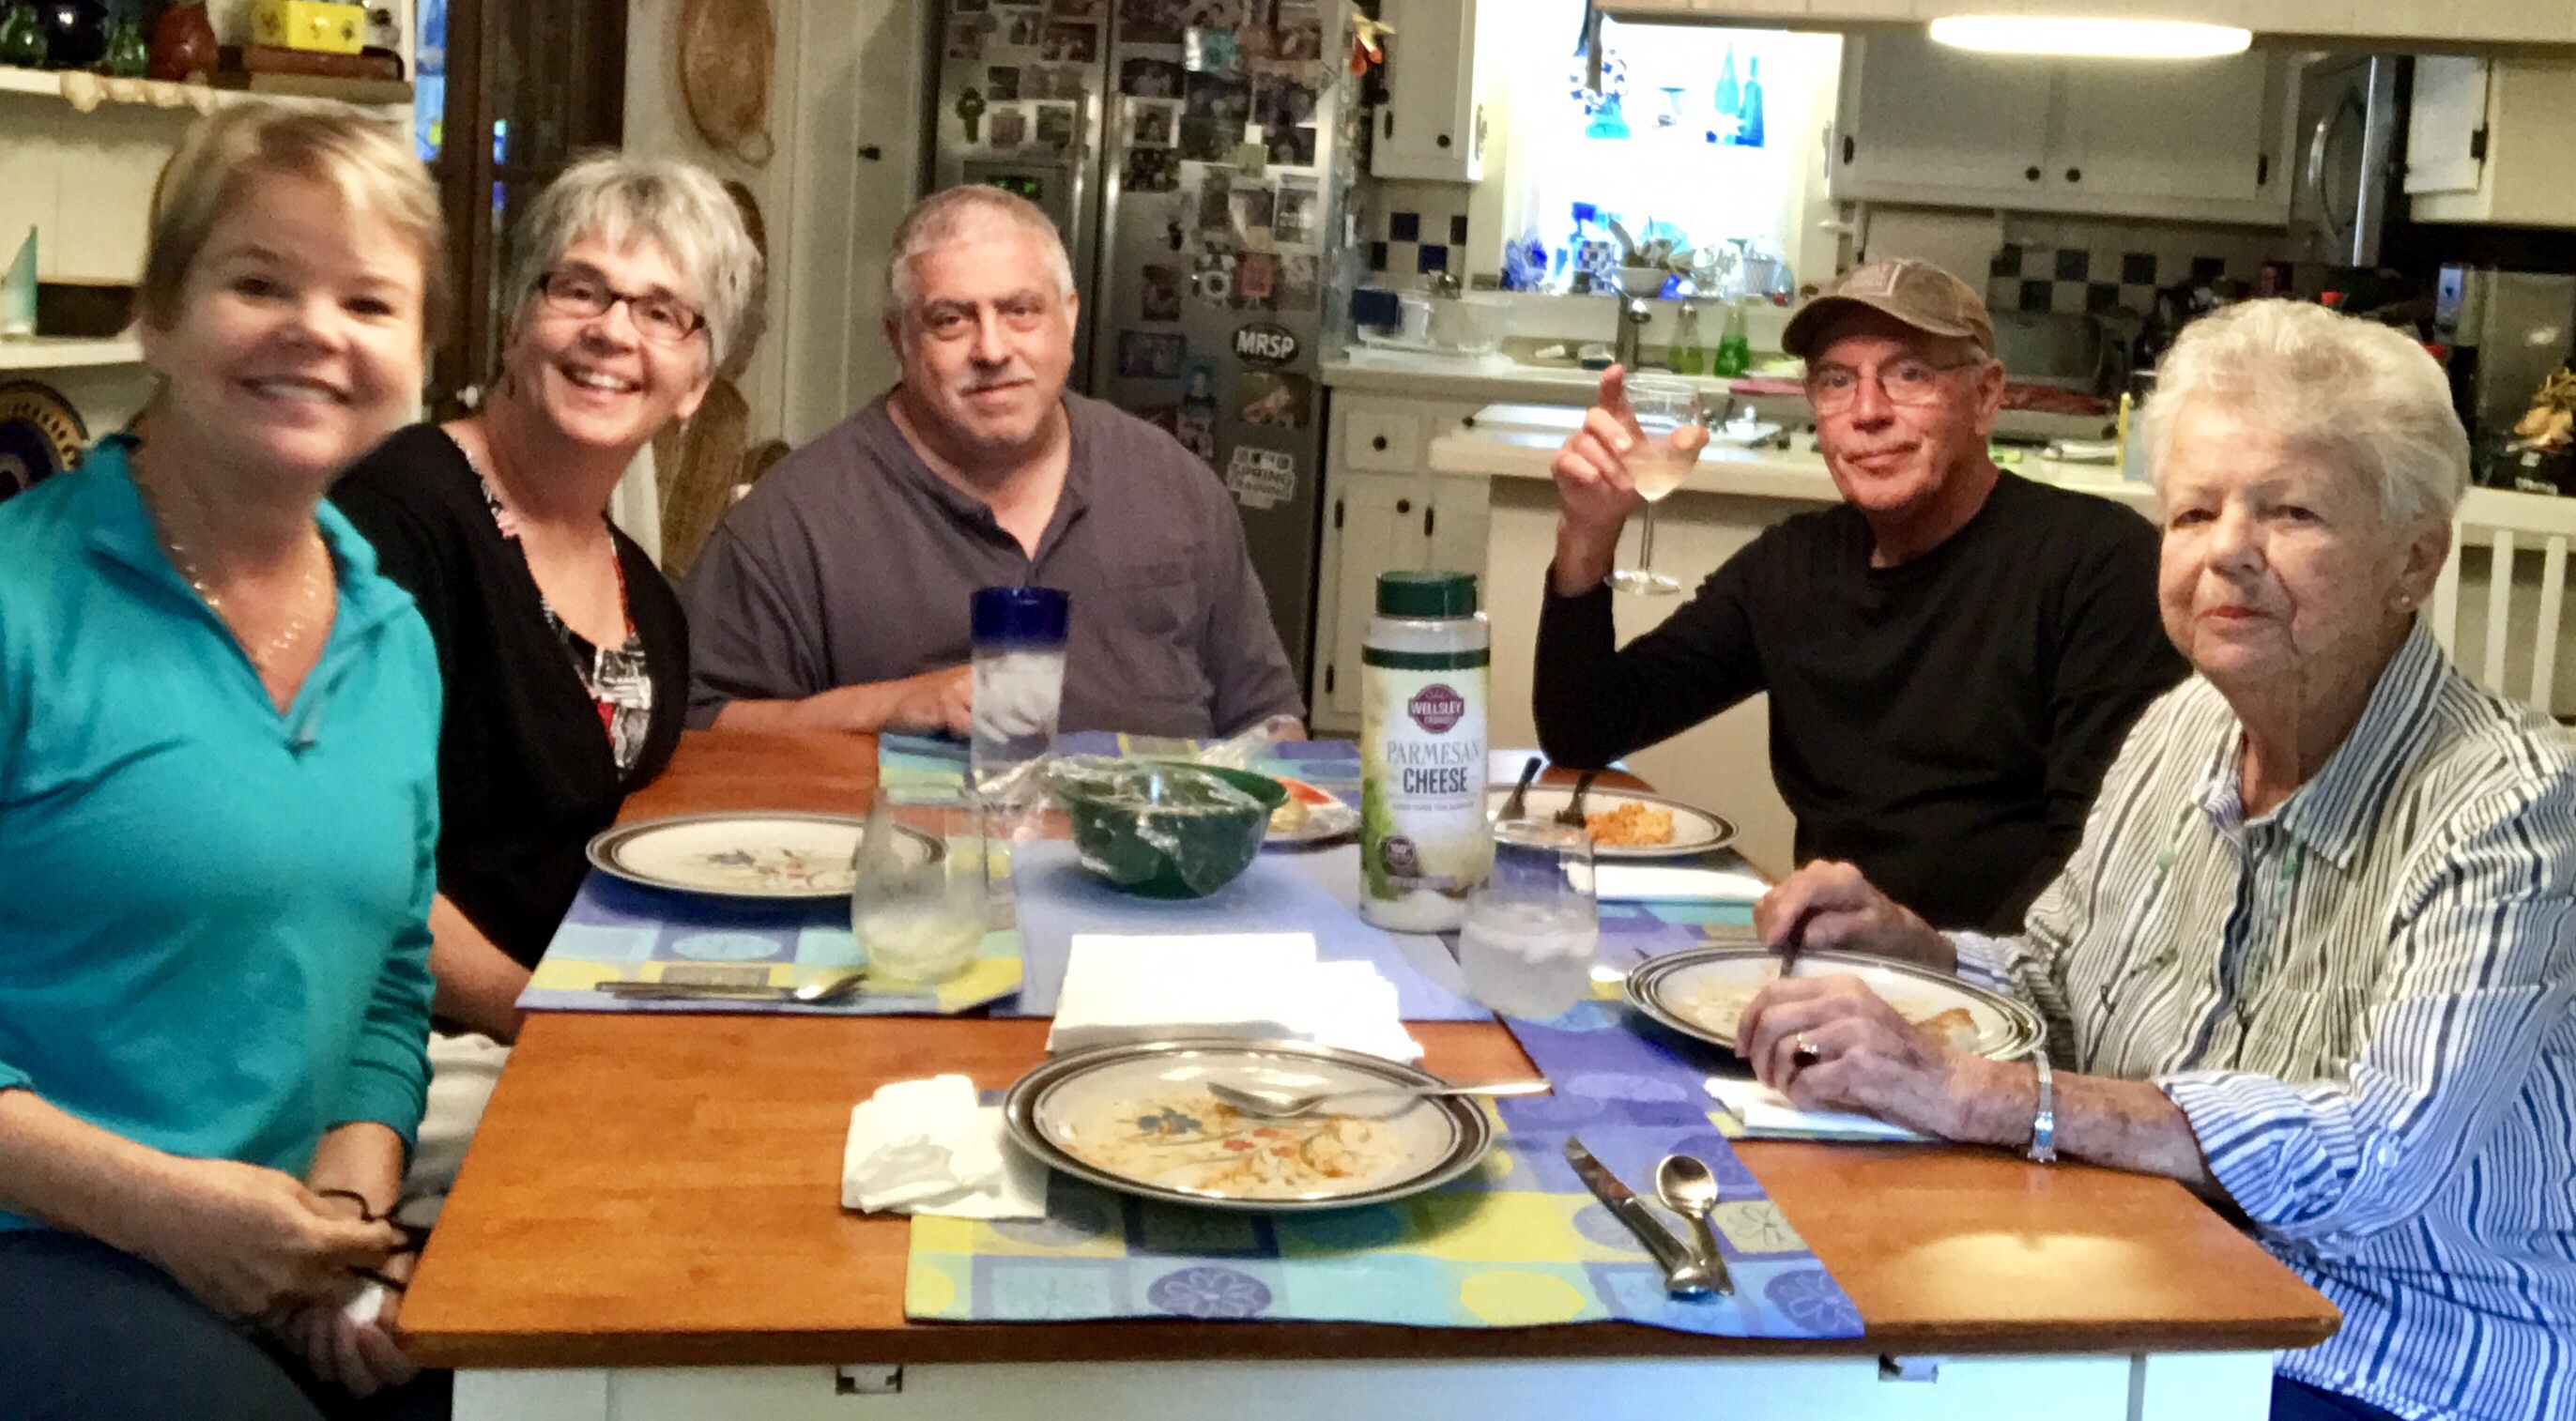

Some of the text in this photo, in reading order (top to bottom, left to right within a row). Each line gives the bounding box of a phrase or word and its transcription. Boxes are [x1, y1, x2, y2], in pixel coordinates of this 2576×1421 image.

[1236, 330, 1295, 359] MRSP
[1411, 701, 1462, 715] WELLSLEY
[1387, 740, 1480, 765] PARMESAN
[1403, 767, 1468, 794] CHEESE
